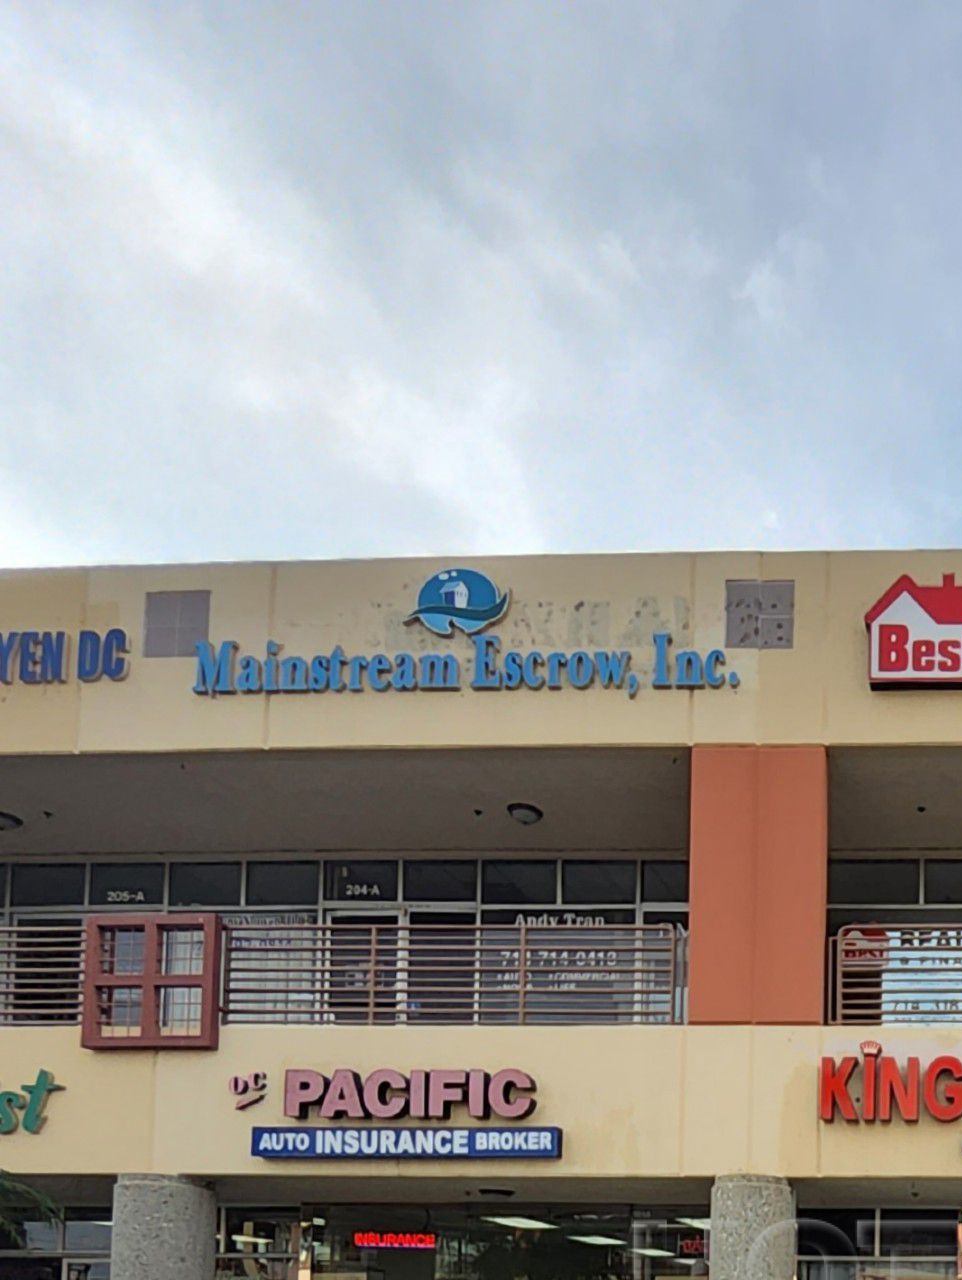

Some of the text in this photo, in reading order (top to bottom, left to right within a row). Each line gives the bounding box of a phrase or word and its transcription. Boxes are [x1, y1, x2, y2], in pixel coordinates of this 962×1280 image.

[77, 628, 131, 683] DC
[192, 633, 740, 699] Mainstream Escrow, Inc.
[282, 1068, 537, 1121] PACIFIC
[258, 1130, 553, 1155] AUTO INSURANCE BROKER
